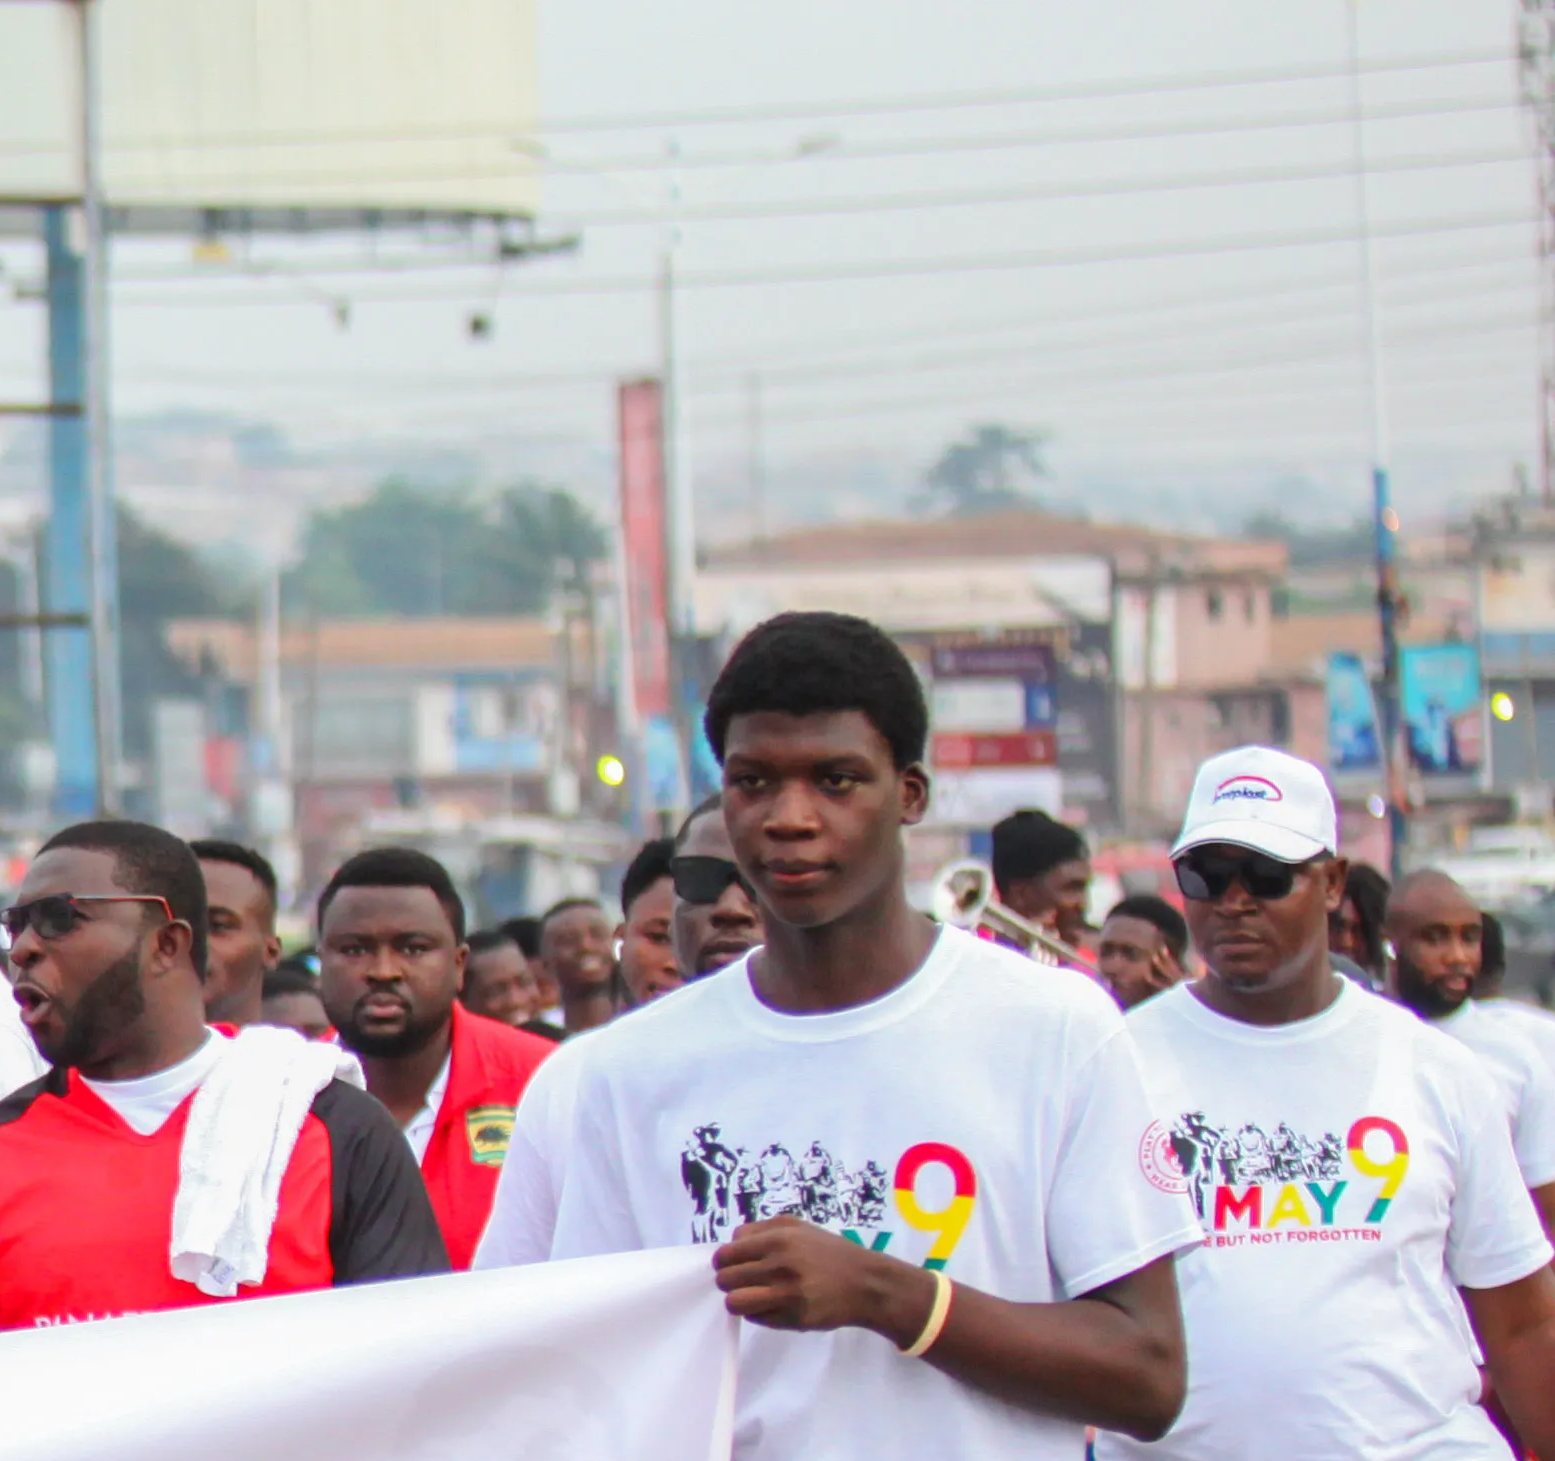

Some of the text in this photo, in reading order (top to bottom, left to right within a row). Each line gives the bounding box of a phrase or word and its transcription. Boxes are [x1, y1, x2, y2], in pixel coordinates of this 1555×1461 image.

[894, 1141, 976, 1271] 9
[1214, 1116, 1409, 1231] MAY 9
[1216, 1234, 1244, 1247] BUT
[1251, 1231, 1282, 1245] NOT
[1287, 1228, 1382, 1243] FORGOTTEN
